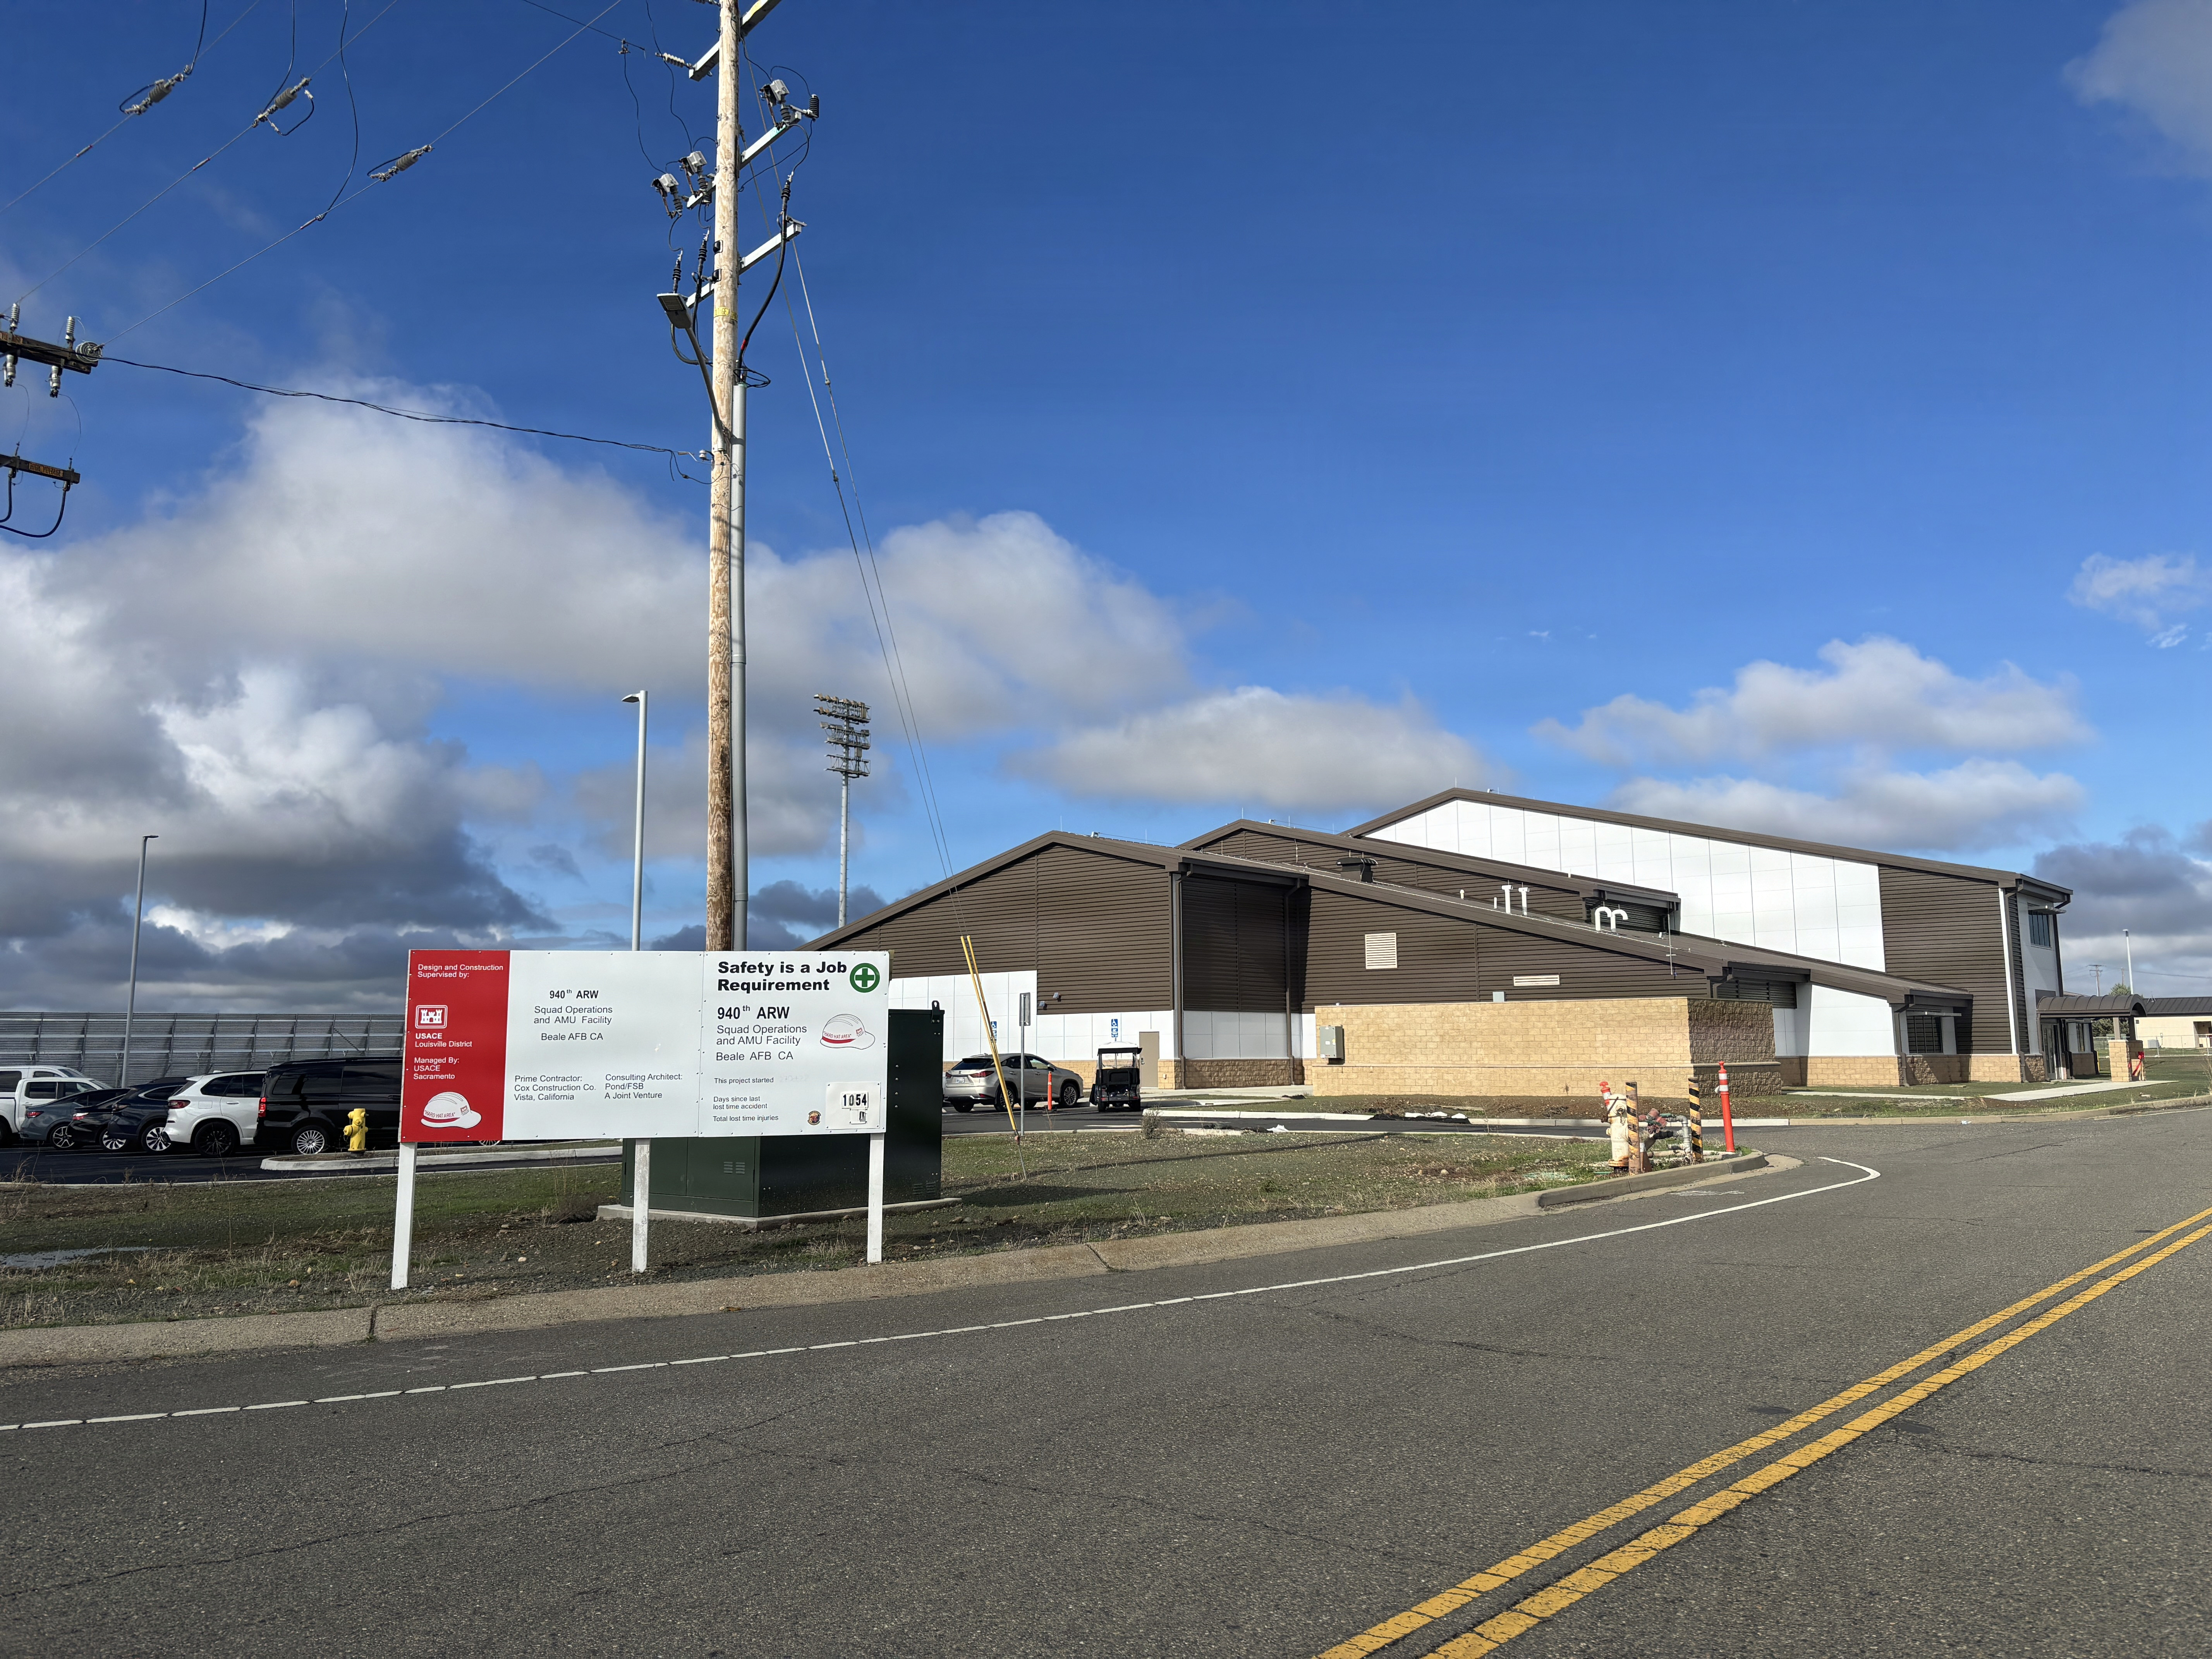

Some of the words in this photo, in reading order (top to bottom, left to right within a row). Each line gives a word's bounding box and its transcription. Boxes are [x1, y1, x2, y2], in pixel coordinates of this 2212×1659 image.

[718, 961, 775, 977] Safety
[780, 961, 794, 973] is
[800, 964, 810, 973] a
[816, 961, 847, 973] Job
[718, 979, 830, 994] Requirement
[576, 990, 599, 999] ARW
[534, 1006, 562, 1015] Squad
[565, 1006, 613, 1015] Operations
[756, 1006, 790, 1019] ARW
[534, 1016, 550, 1024] and
[582, 1016, 612, 1025] Facility
[717, 1025, 749, 1036] Squad
[753, 1024, 807, 1036] Operations
[716, 1036, 735, 1045] and
[737, 1036, 762, 1045] AMU
[766, 1036, 801, 1046] Facility
[716, 1052, 745, 1061] Beale
[749, 1051, 771, 1060] AFB
[778, 1051, 793, 1060] CA
[605, 1074, 646, 1082] Consulting
[843, 1094, 867, 1106] 1054
